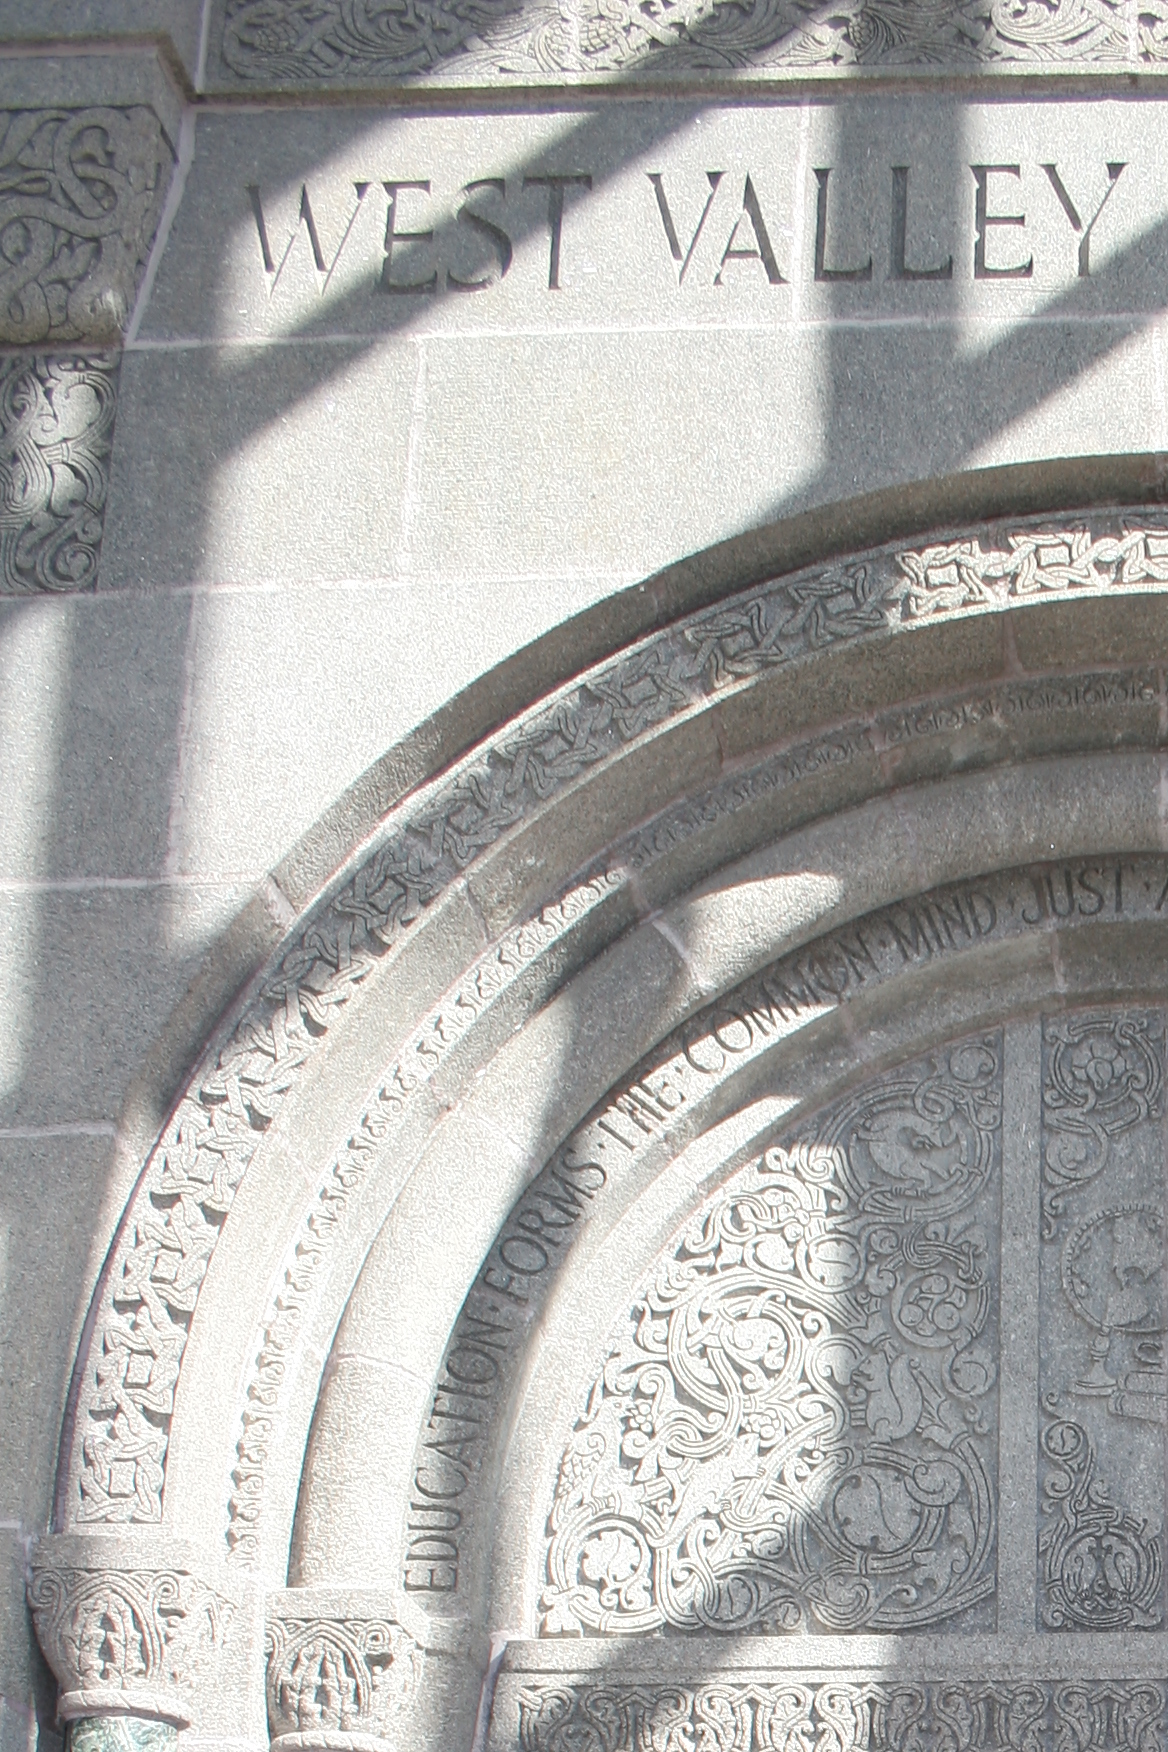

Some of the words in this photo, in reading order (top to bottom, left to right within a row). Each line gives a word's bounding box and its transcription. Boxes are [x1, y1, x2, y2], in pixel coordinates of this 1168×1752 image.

[244, 172, 594, 299] WEST
[645, 160, 1131, 287] VALLEY
[403, 1313, 514, 1593] EDUCATION
[483, 1147, 608, 1307] FORMS
[591, 1075, 686, 1152] THE
[682, 930, 880, 1075] COMMON
[885, 891, 998, 962] MIND
[1021, 862, 1137, 925] JUST
